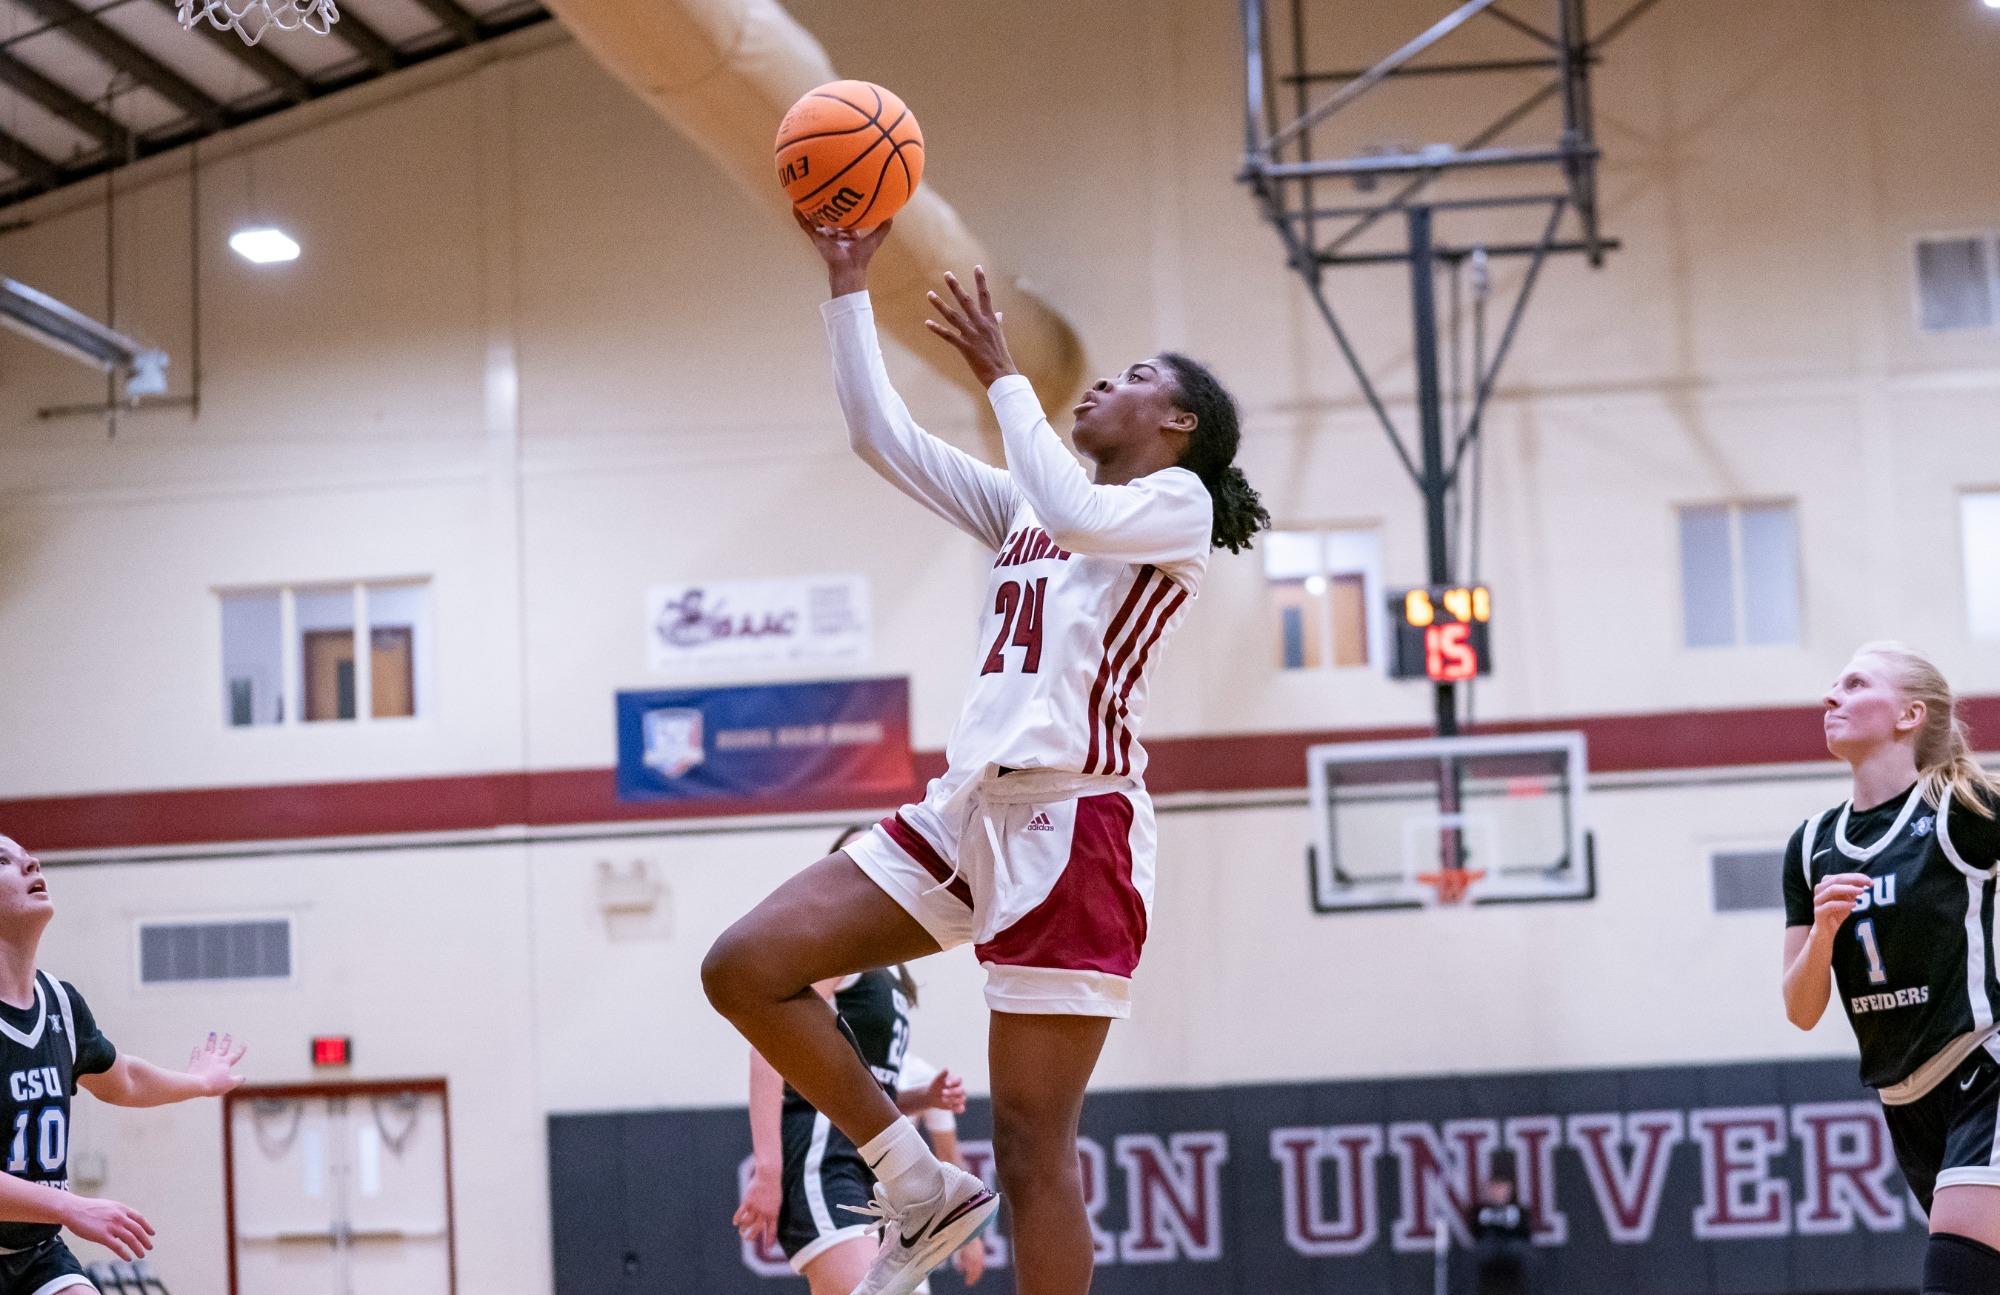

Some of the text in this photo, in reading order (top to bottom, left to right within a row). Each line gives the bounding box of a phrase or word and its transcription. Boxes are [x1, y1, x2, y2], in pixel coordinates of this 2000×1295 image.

[979, 576, 1049, 678] 24
[1424, 623, 1478, 681] 15
[1027, 823, 1055, 832] adidas
[1855, 918, 1887, 984] 1
[9, 1066, 63, 1102] CSU
[7, 1106, 67, 1173] 10
[1270, 1099, 1926, 1257] UNIVER
